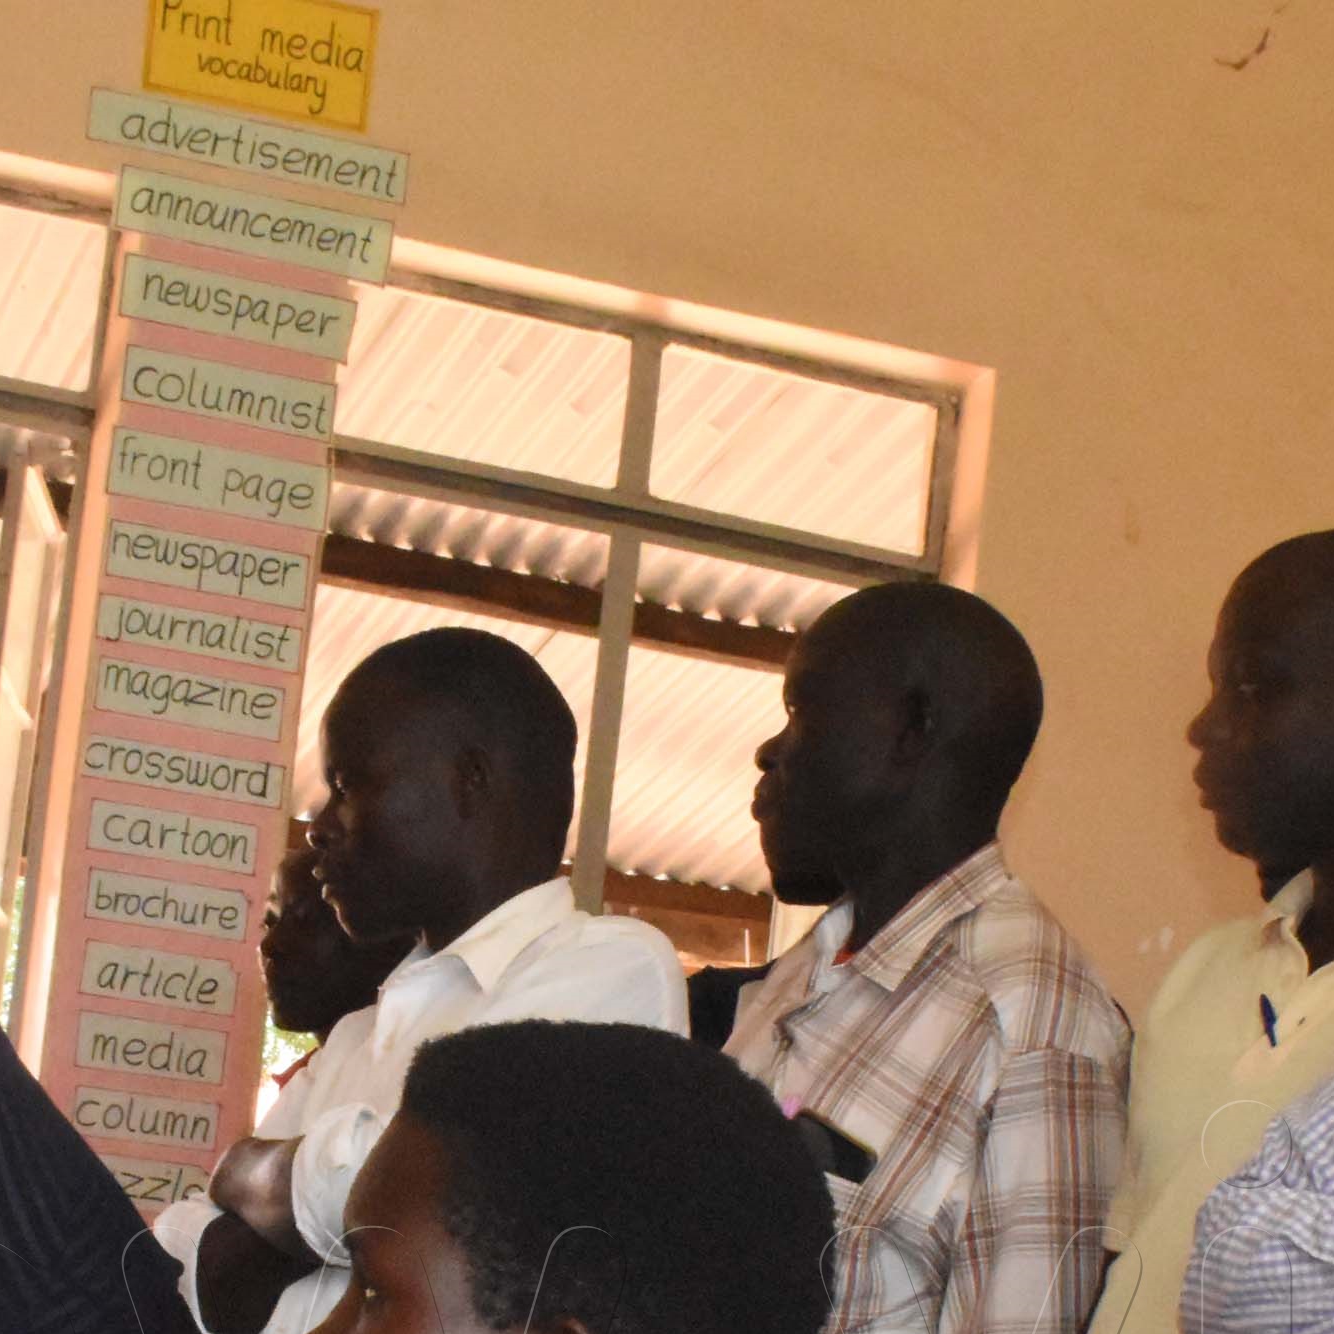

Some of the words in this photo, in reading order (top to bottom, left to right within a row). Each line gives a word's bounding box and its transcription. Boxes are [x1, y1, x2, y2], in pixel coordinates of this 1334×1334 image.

[159, 0, 233, 46] Print
[261, 22, 364, 73] media
[197, 51, 327, 115] vocabulary
[120, 109, 400, 199] advertisement
[130, 185, 373, 264] announcement
[142, 271, 340, 340] newspaper
[132, 365, 330, 435] columnist
[117, 437, 202, 491] front
[221, 466, 315, 518] page
[111, 529, 300, 596] newspaper
[106, 604, 292, 664] journalist
[103, 662, 277, 721] magazine
[84, 740, 273, 798] crossword
[102, 813, 249, 864] cartoon
[94, 879, 239, 931] brochure
[97, 958, 219, 1005] article
[91, 1031, 208, 1078] media
[75, 1098, 211, 1144] column
[119, 1167, 206, 1204] zzle
